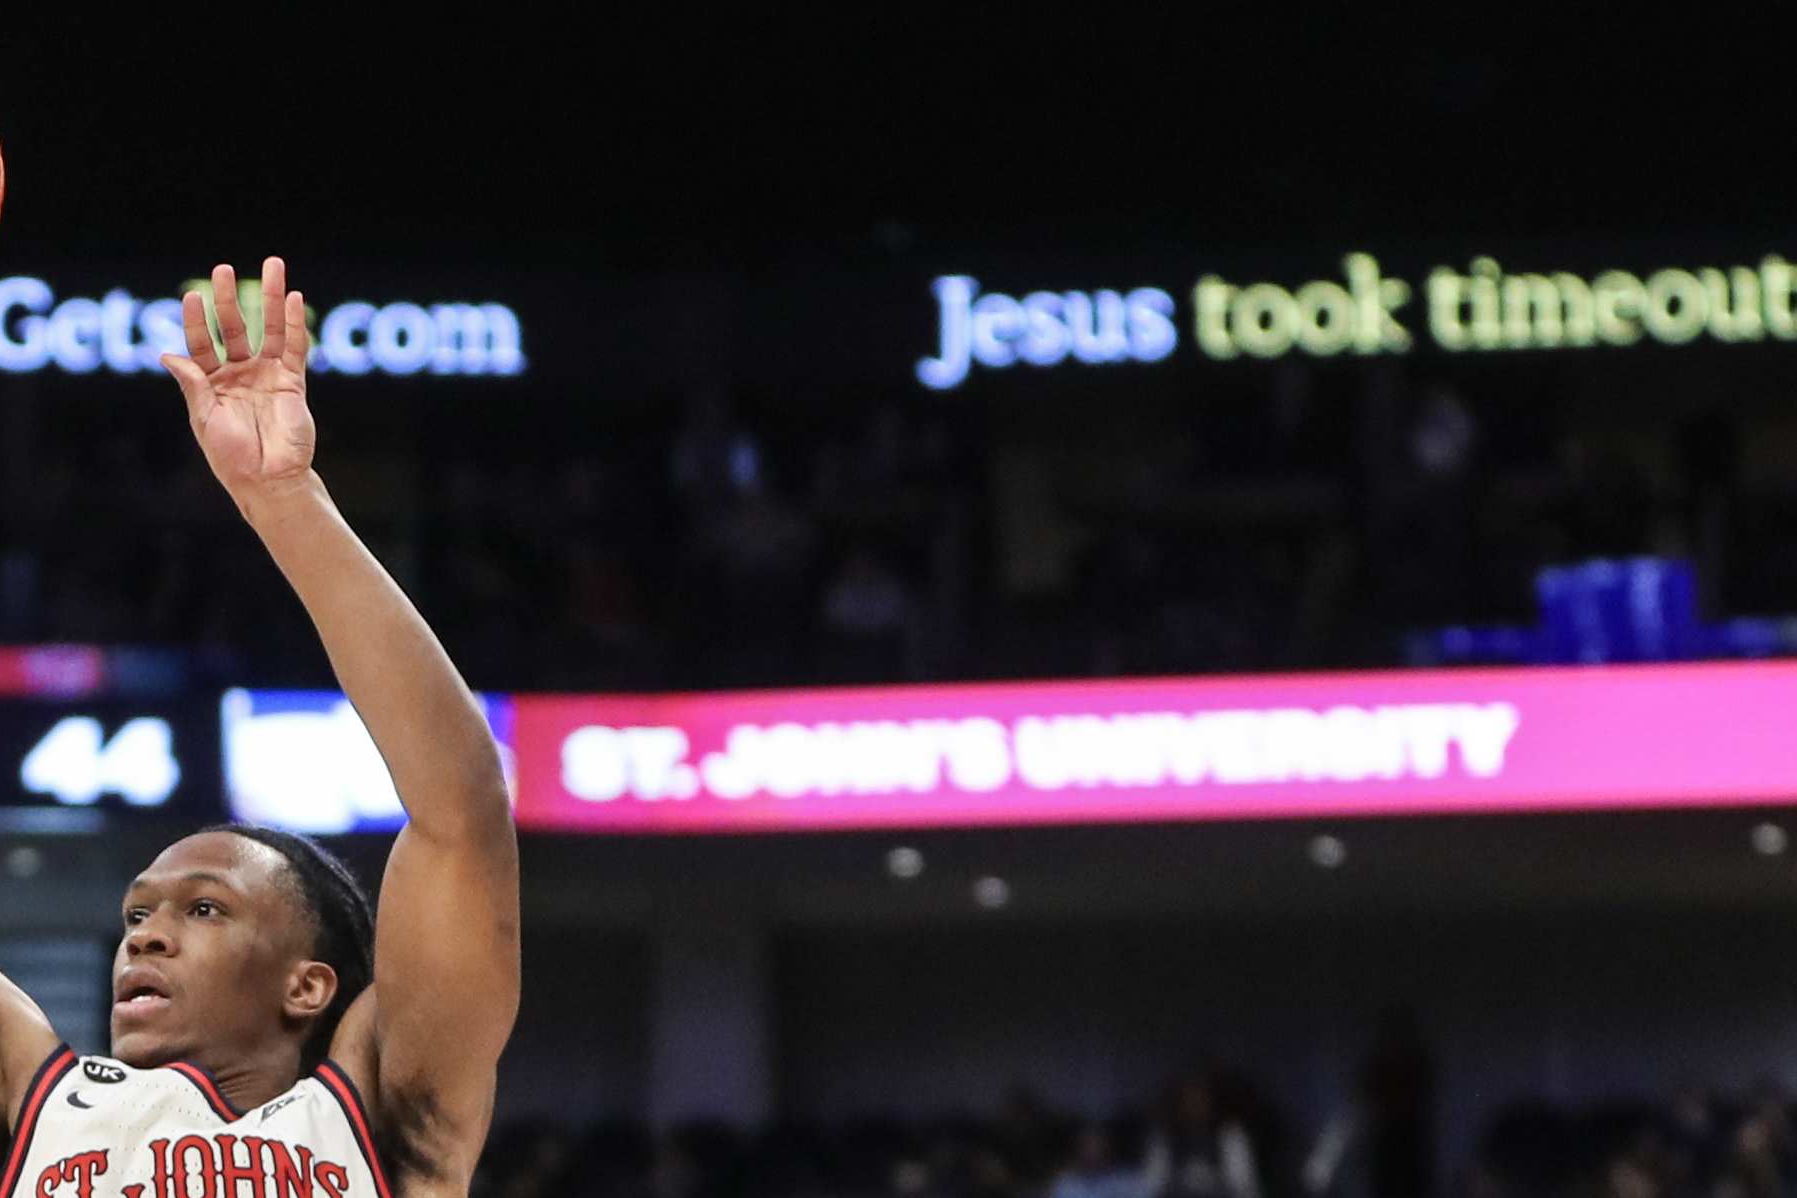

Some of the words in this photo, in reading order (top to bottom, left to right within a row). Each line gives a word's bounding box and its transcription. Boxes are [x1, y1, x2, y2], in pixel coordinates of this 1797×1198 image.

[915, 275, 1178, 389] Jesus
[1192, 253, 1410, 359] took
[21, 716, 180, 804] 44
[561, 725, 700, 801] ST.
[87, 1064, 120, 1081] JK
